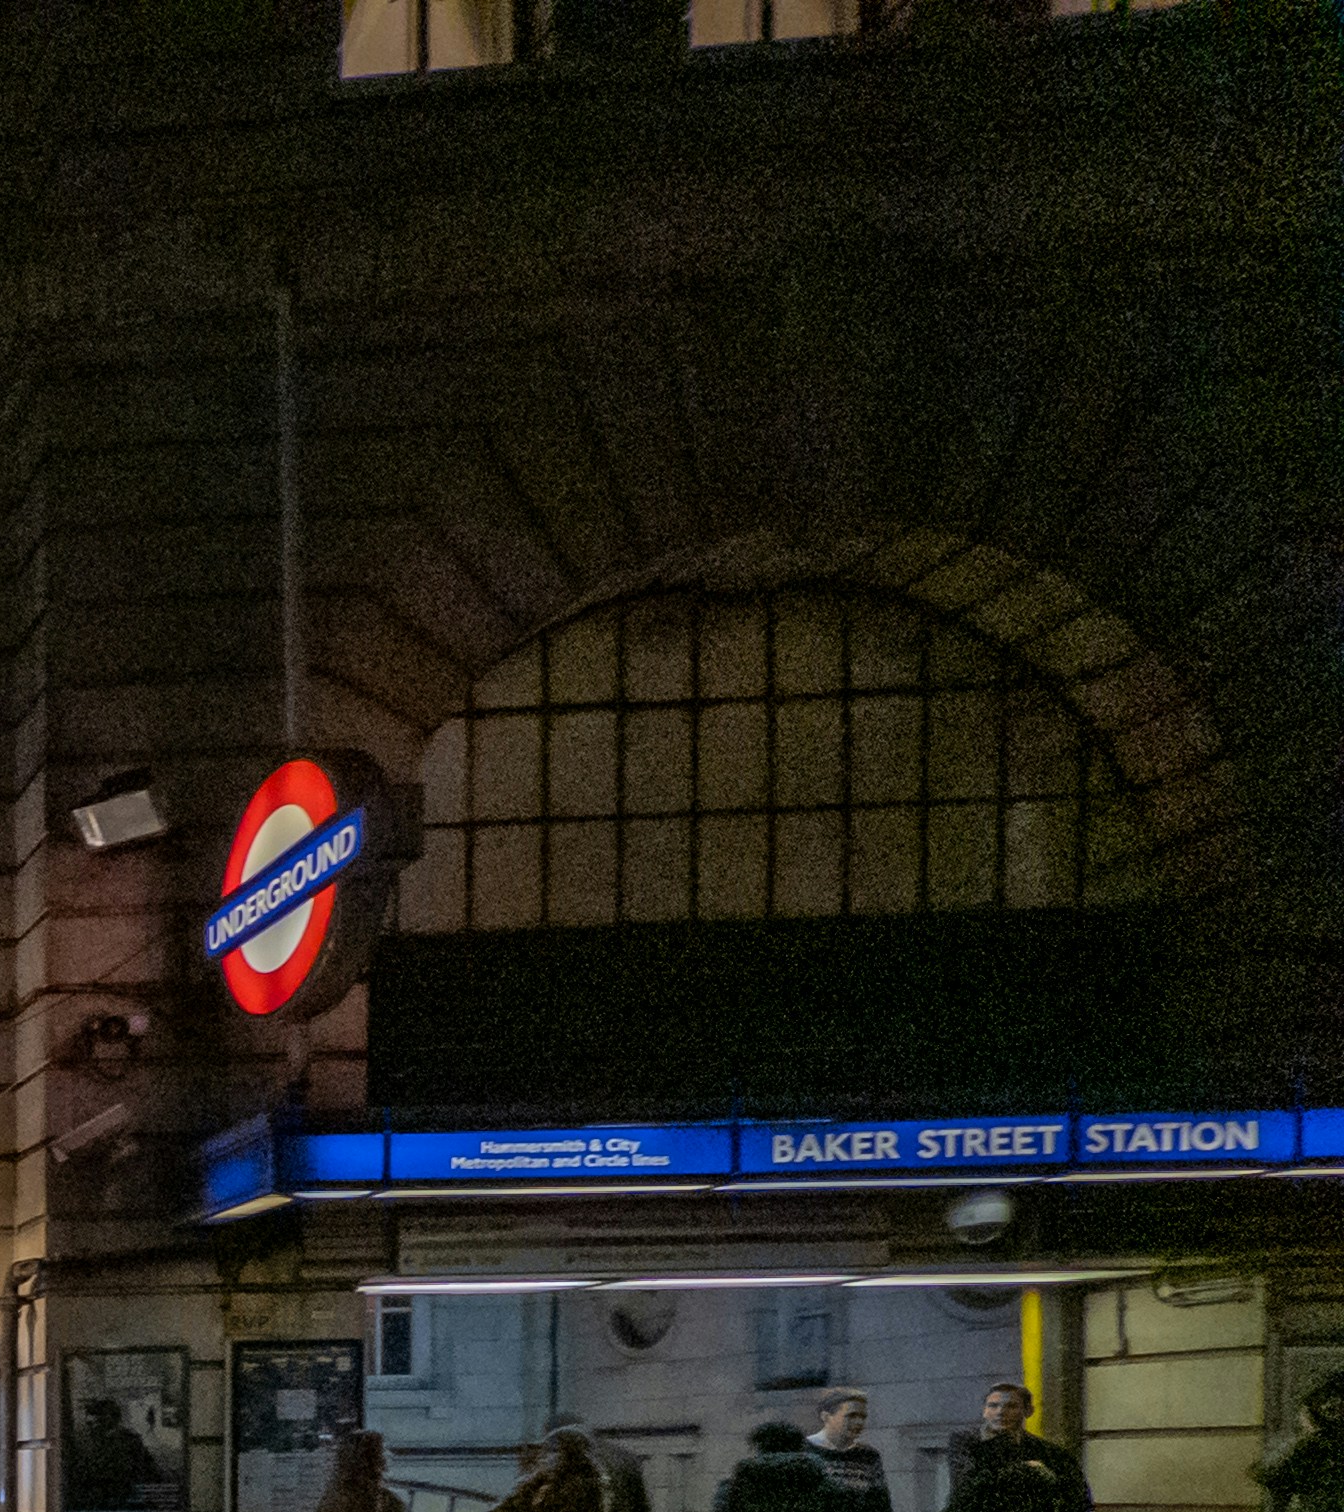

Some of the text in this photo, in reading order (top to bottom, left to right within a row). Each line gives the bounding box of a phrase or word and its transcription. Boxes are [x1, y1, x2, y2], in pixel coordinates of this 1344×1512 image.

[208, 824, 357, 951] UNDERGROUND
[480, 1138, 641, 1154] Hammersmith & City
[772, 1120, 1259, 1164] BAKER STREET STATION
[450, 1154, 680, 1171] Metropolitan and Circle lines
